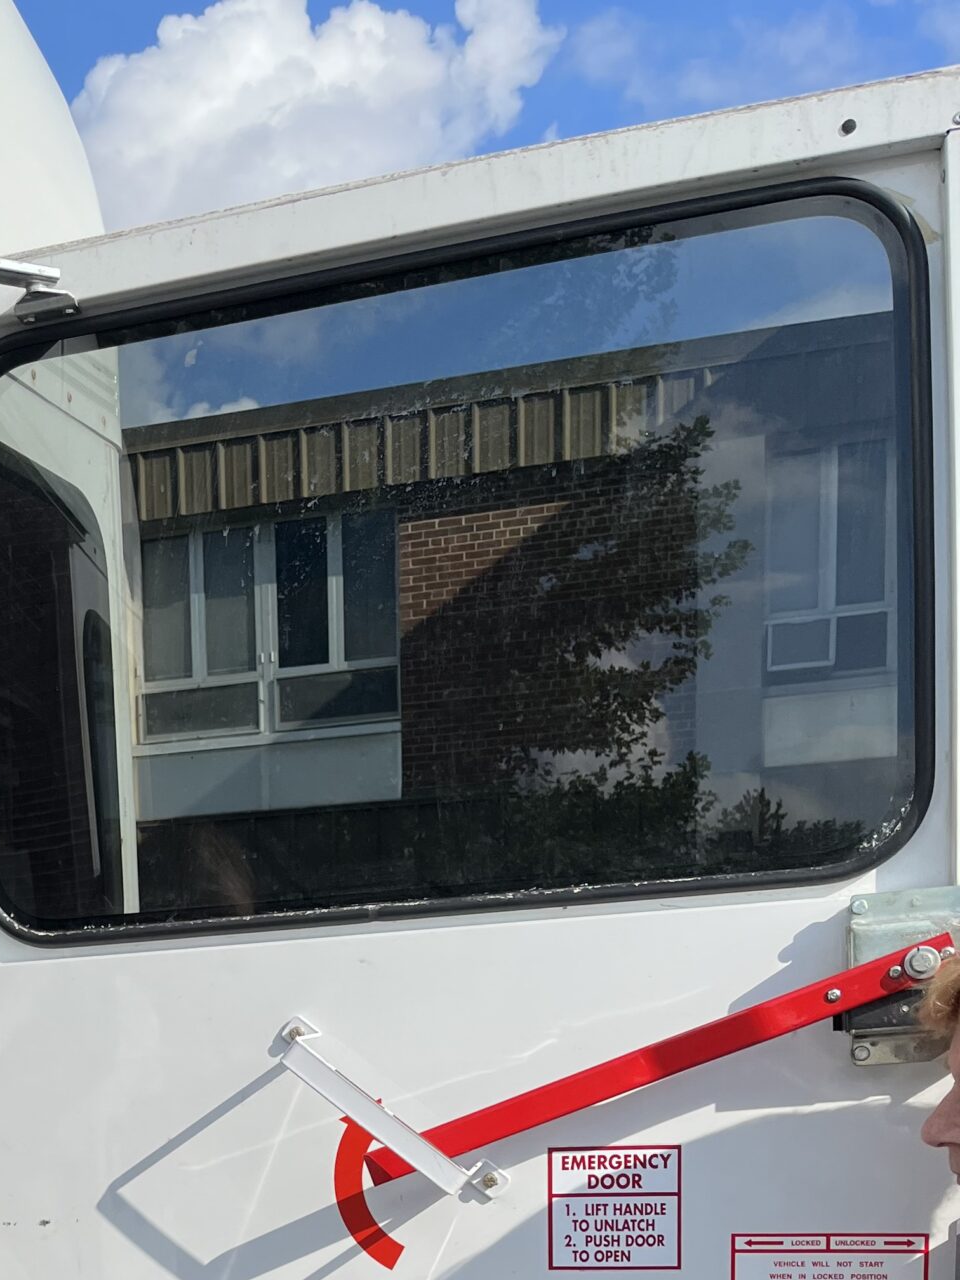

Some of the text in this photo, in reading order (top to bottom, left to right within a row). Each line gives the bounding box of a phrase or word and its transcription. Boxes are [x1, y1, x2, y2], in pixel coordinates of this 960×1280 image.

[561, 1153, 672, 1171] EMERGENCY
[587, 1173, 643, 1190] DOOR
[565, 1202, 667, 1217] 1. LIFT HANDLE
[571, 1218, 656, 1233] TO UNLATCH
[564, 1234, 666, 1248] 2. PUSH DOOR
[790, 1239, 877, 1247] LOCKED UNLOCKED
[571, 1249, 631, 1263] TO OPEN
[773, 1260, 885, 1268] VEHICLE WILL NOT START
[768, 1272, 888, 1280] WHEN IN LOCKED POSITION
